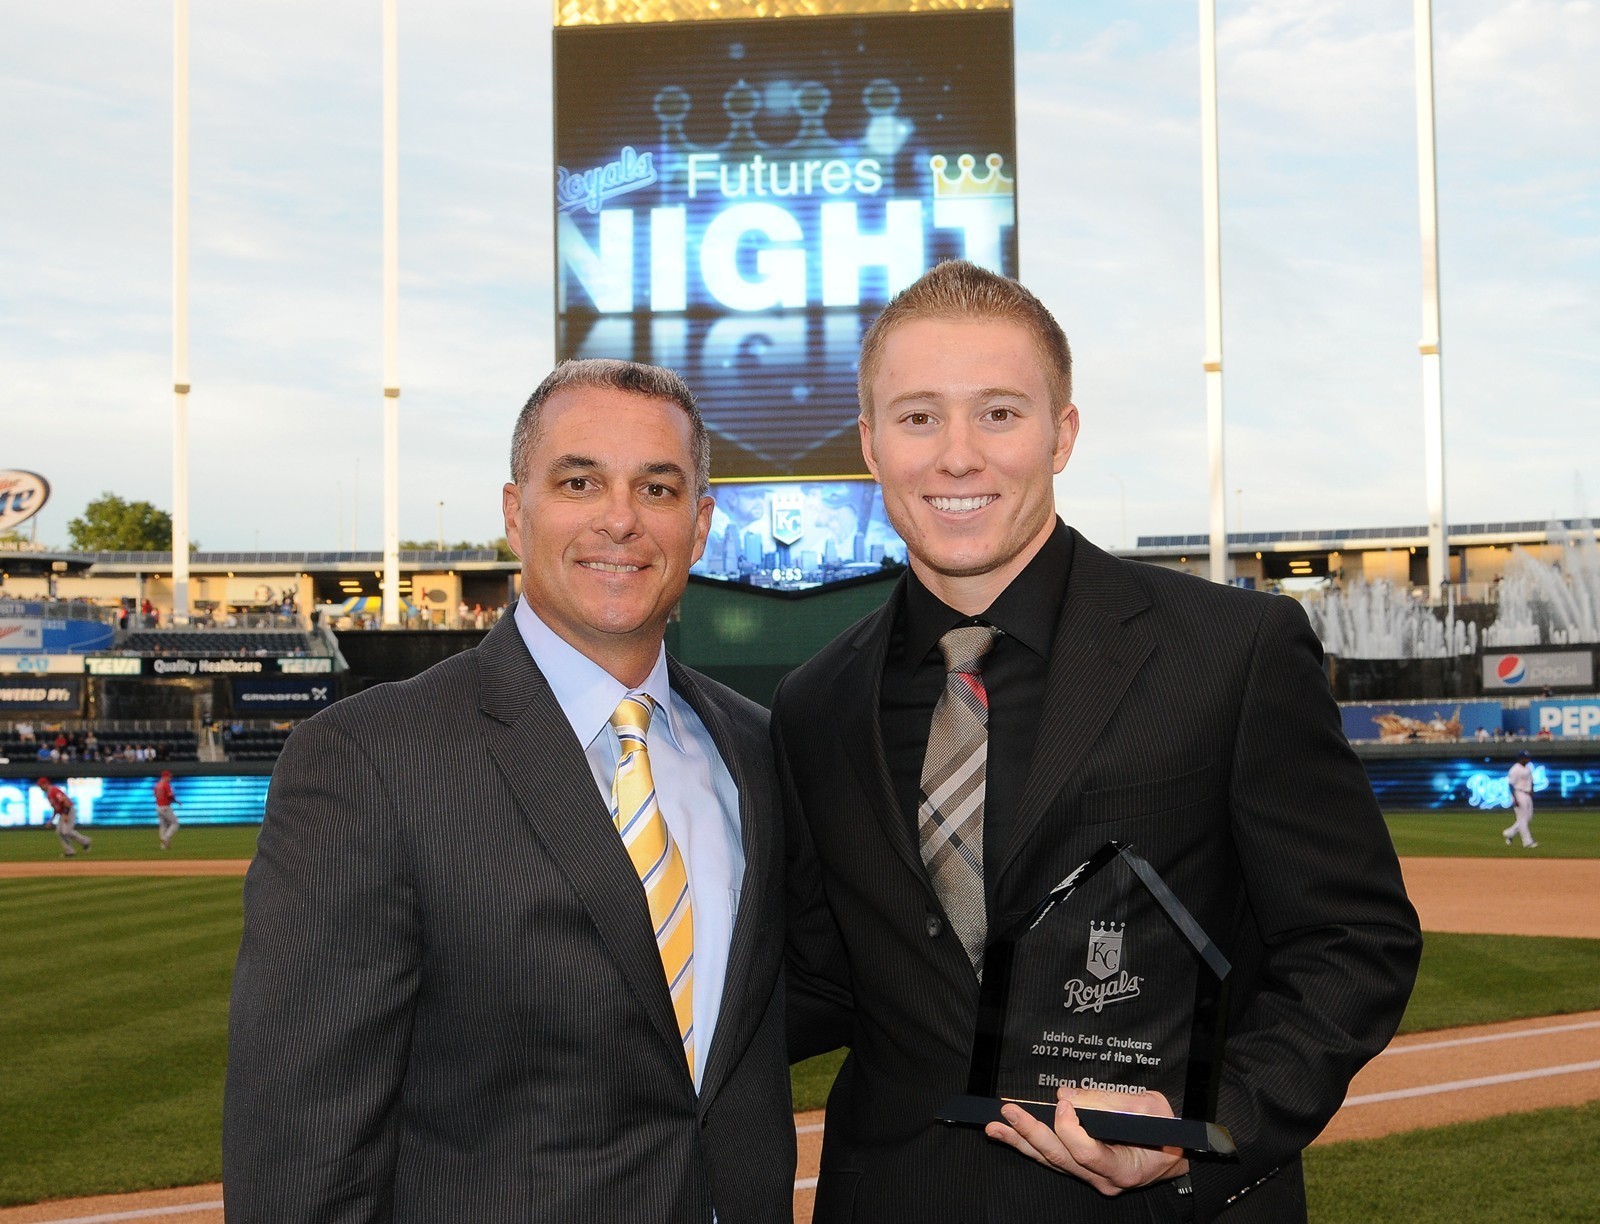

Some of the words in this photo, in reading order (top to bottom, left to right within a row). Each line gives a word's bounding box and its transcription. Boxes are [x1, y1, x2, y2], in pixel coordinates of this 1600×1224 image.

[687, 152, 883, 199] Futures
[558, 198, 1014, 314] NIGHT
[85, 657, 141, 675] TEVA
[154, 659, 197, 675] Quality
[199, 658, 262, 673] Healthcare
[277, 657, 332, 674] TEVA
[1540, 705, 1600, 736] PEP
[1090, 941, 1119, 971] KC
[1064, 970, 1141, 1014] Royals
[1042, 1031, 1075, 1043] Idaho
[1078, 1034, 1103, 1046] Falls
[1106, 1037, 1153, 1050] Chukars
[1031, 1044, 1059, 1056] 2012
[1062, 1047, 1097, 1061] Player
[1100, 1051, 1112, 1061] of
[1114, 1052, 1132, 1063] the
[1135, 1053, 1161, 1066] Year
[1038, 1073, 1077, 1089] Ethan
[1080, 1077, 1147, 1096] Chapman
